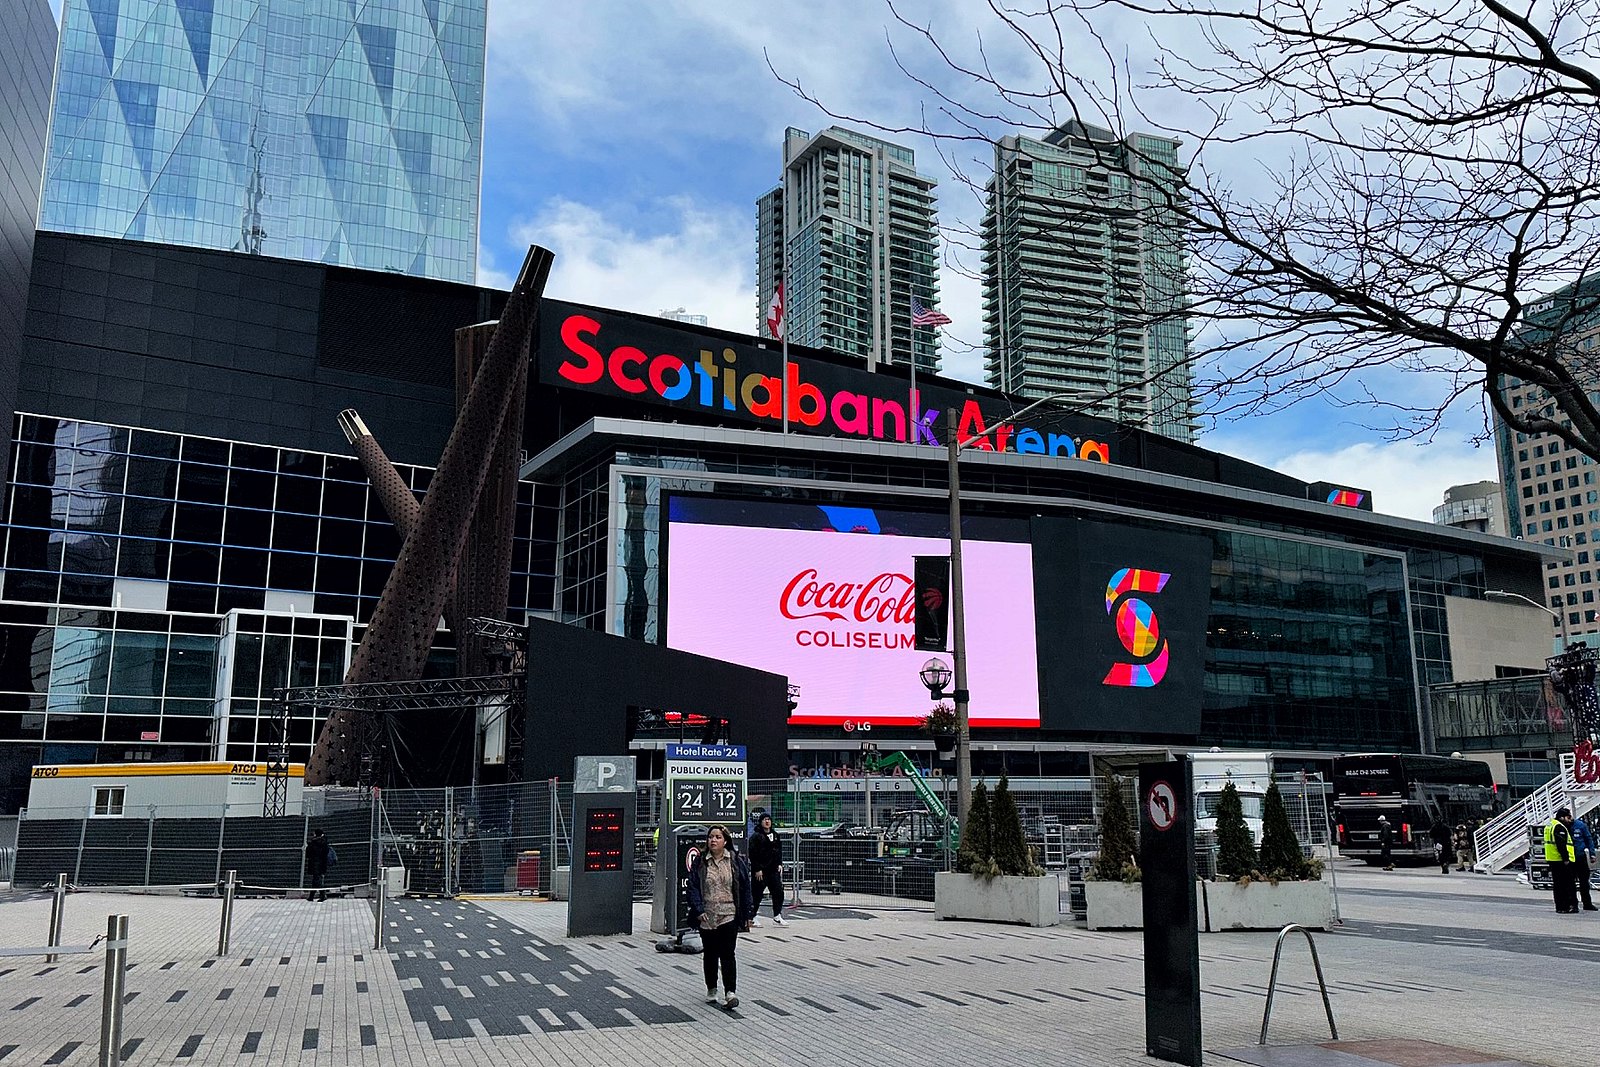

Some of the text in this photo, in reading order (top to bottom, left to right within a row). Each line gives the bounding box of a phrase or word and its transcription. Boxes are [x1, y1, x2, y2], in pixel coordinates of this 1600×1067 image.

[1527, 300, 1554, 317] AON
[558, 314, 1110, 464] Scotiabank Arena
[796, 630, 915, 650] COLISEUM
[857, 721, 871, 731] LG
[676, 747, 738, 757] Hotel Rate '24
[33, 768, 59, 777] ATCO
[231, 764, 257, 773] ATCO
[597, 762, 616, 788] P
[671, 766, 744, 775] PUBLIC PARKING
[814, 782, 900, 790] GATE 6
[677, 792, 704, 809] $24
[712, 793, 737, 809] $12
